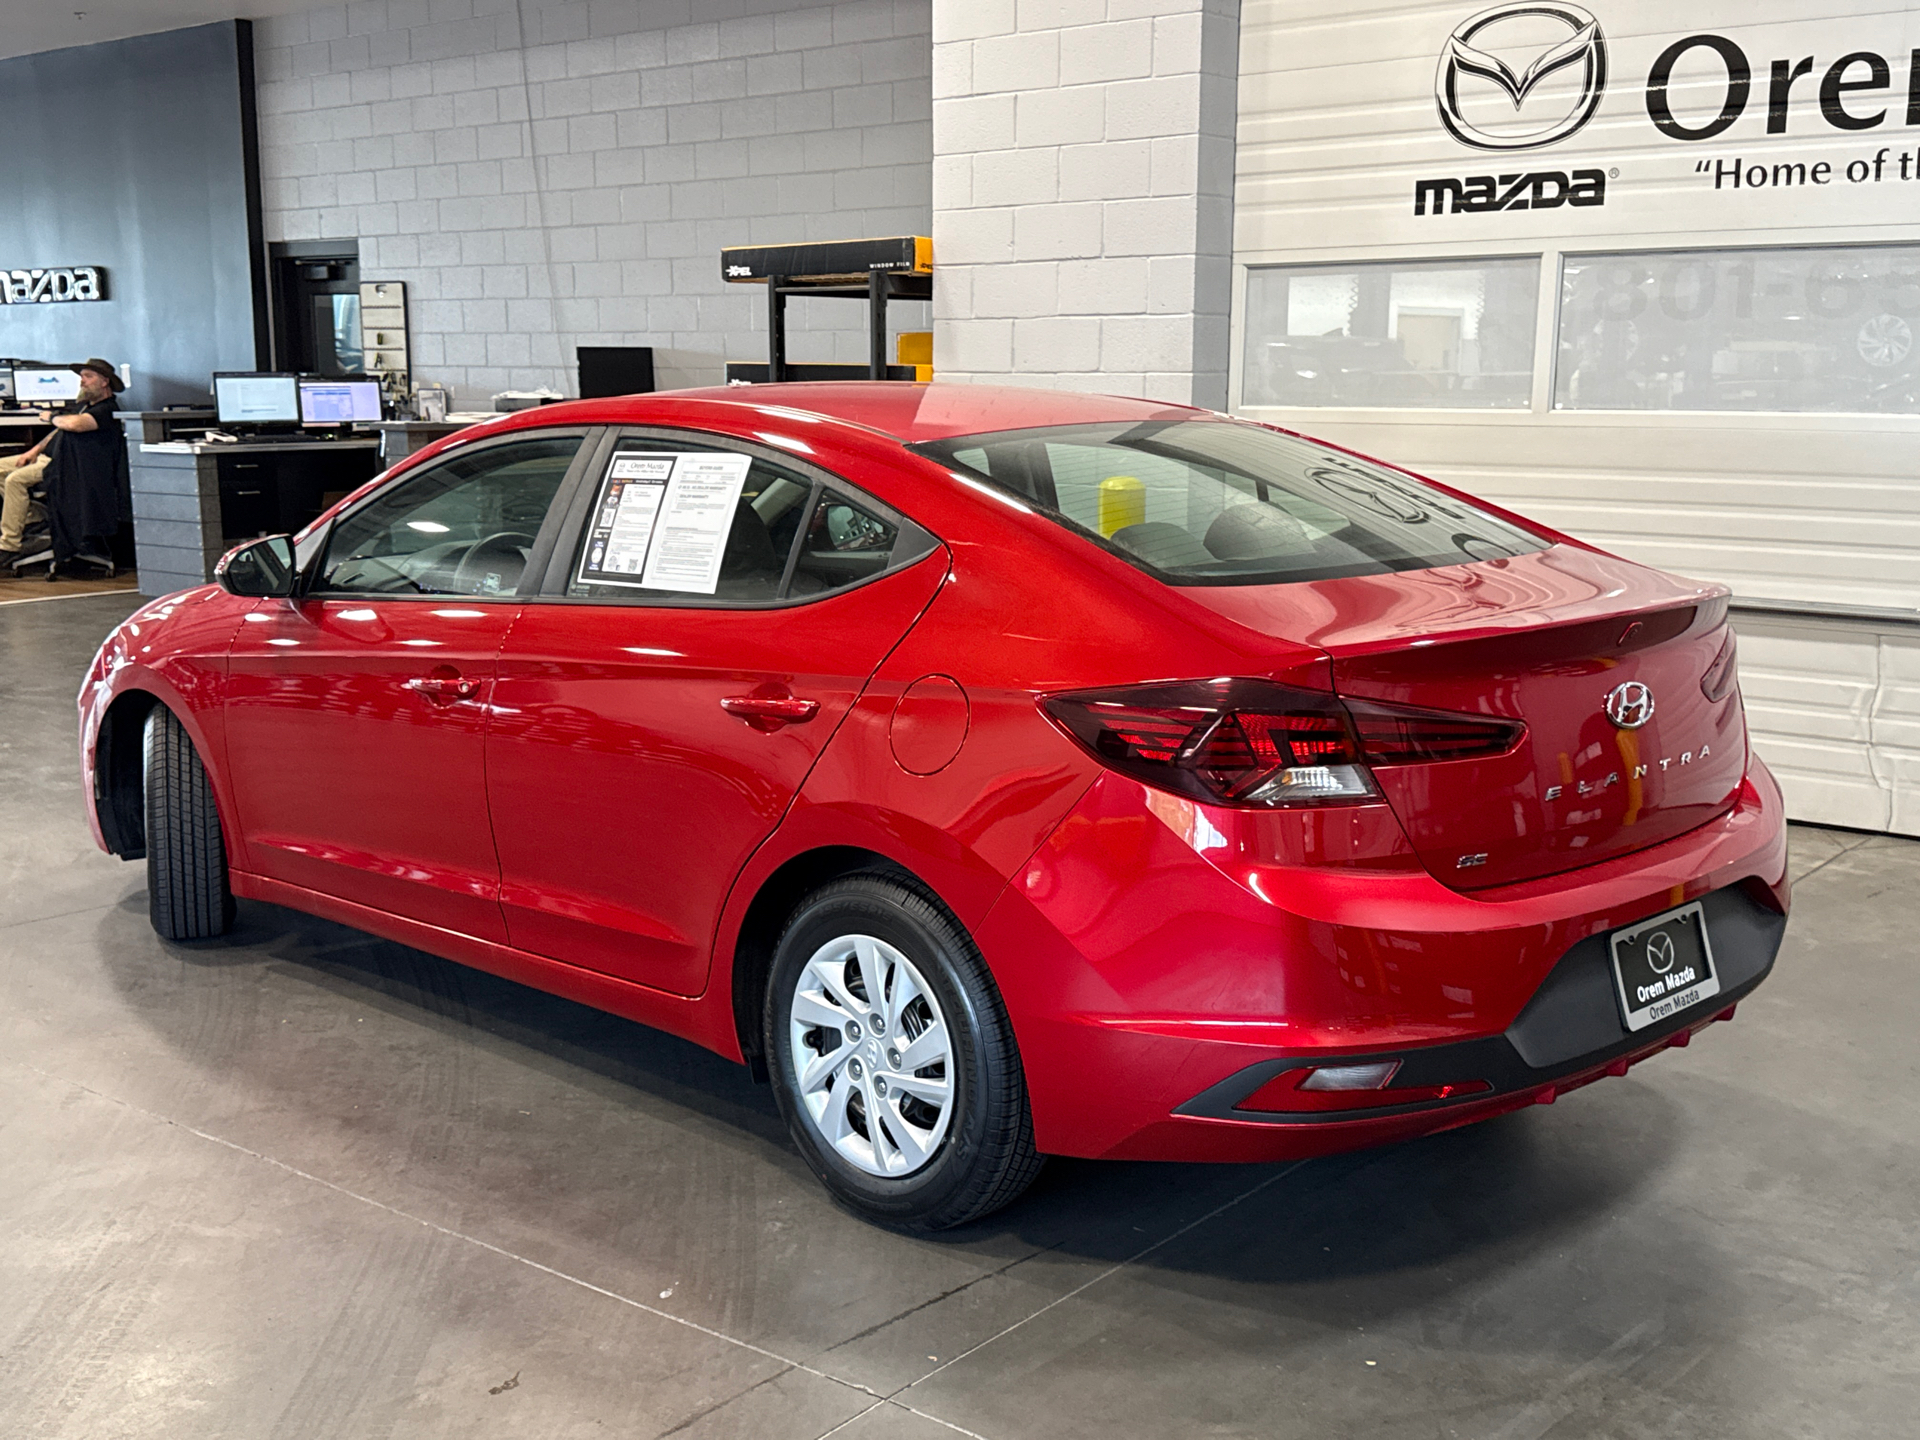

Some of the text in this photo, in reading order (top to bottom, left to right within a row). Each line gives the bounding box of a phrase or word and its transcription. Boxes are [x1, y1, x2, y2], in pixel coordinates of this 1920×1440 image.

[1846, 148, 1890, 182] of
[725, 265, 752, 277] XPEL
[1545, 744, 1711, 801] ELANTRA
[1456, 852, 1488, 869] SE
[1637, 965, 1696, 1003] Orem Mazda
[1649, 989, 1700, 1020] Orem Mazda
